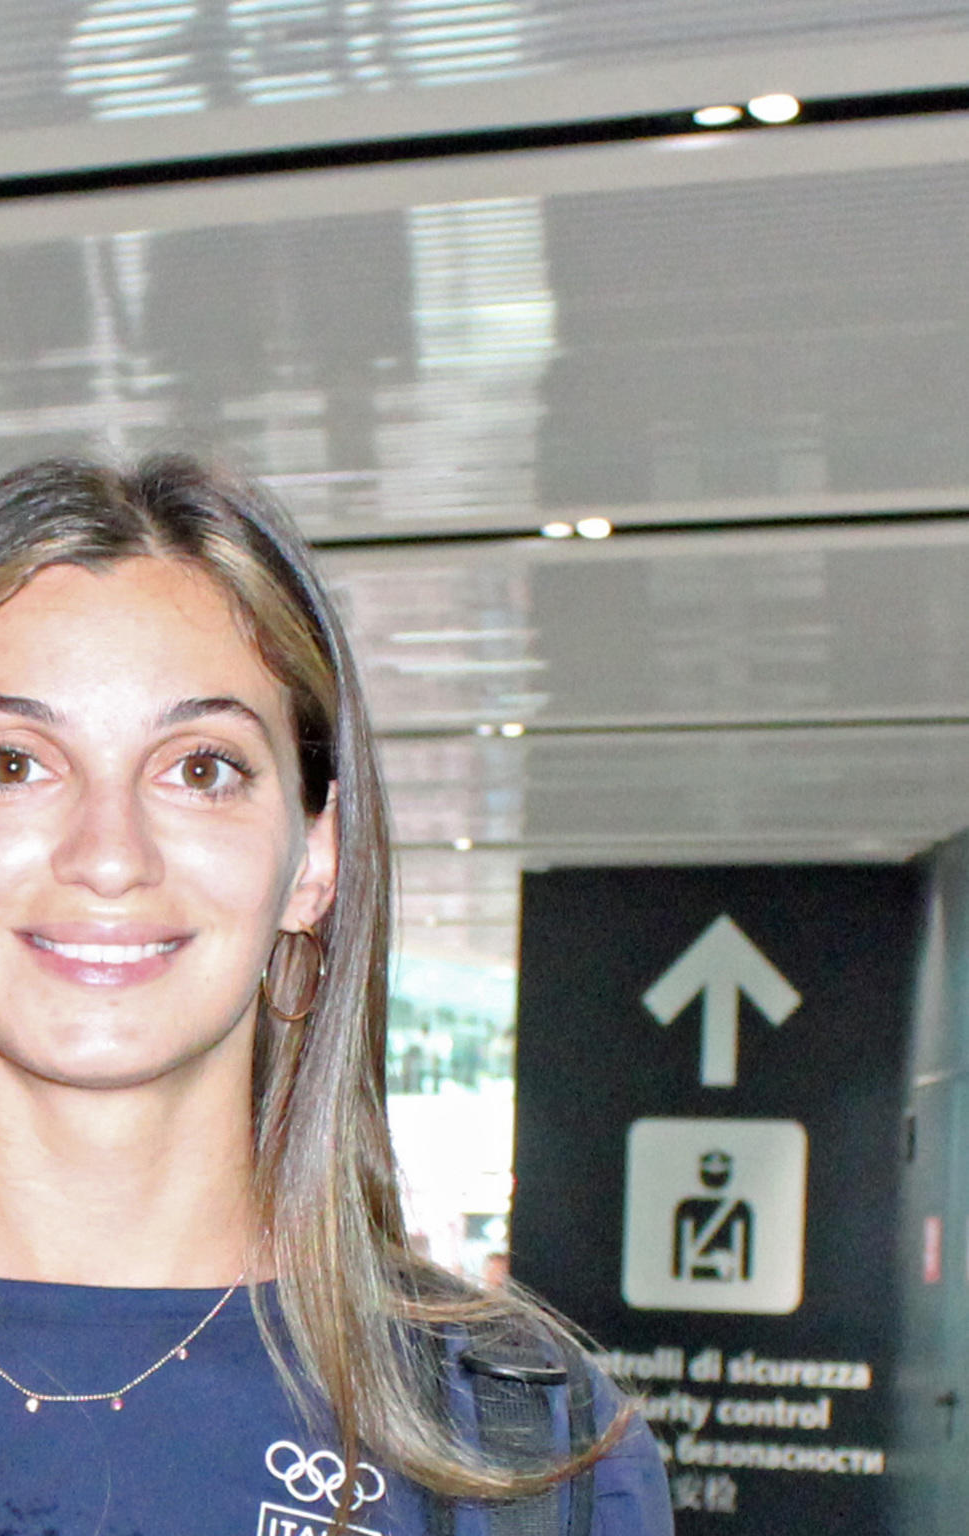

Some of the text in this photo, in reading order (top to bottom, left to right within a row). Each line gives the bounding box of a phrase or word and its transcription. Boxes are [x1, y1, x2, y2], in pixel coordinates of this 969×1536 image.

[588, 1347, 872, 1390] ntrolli di sicurezza
[641, 1392, 830, 1432] urity control
[675, 1433, 885, 1475] безопасности
